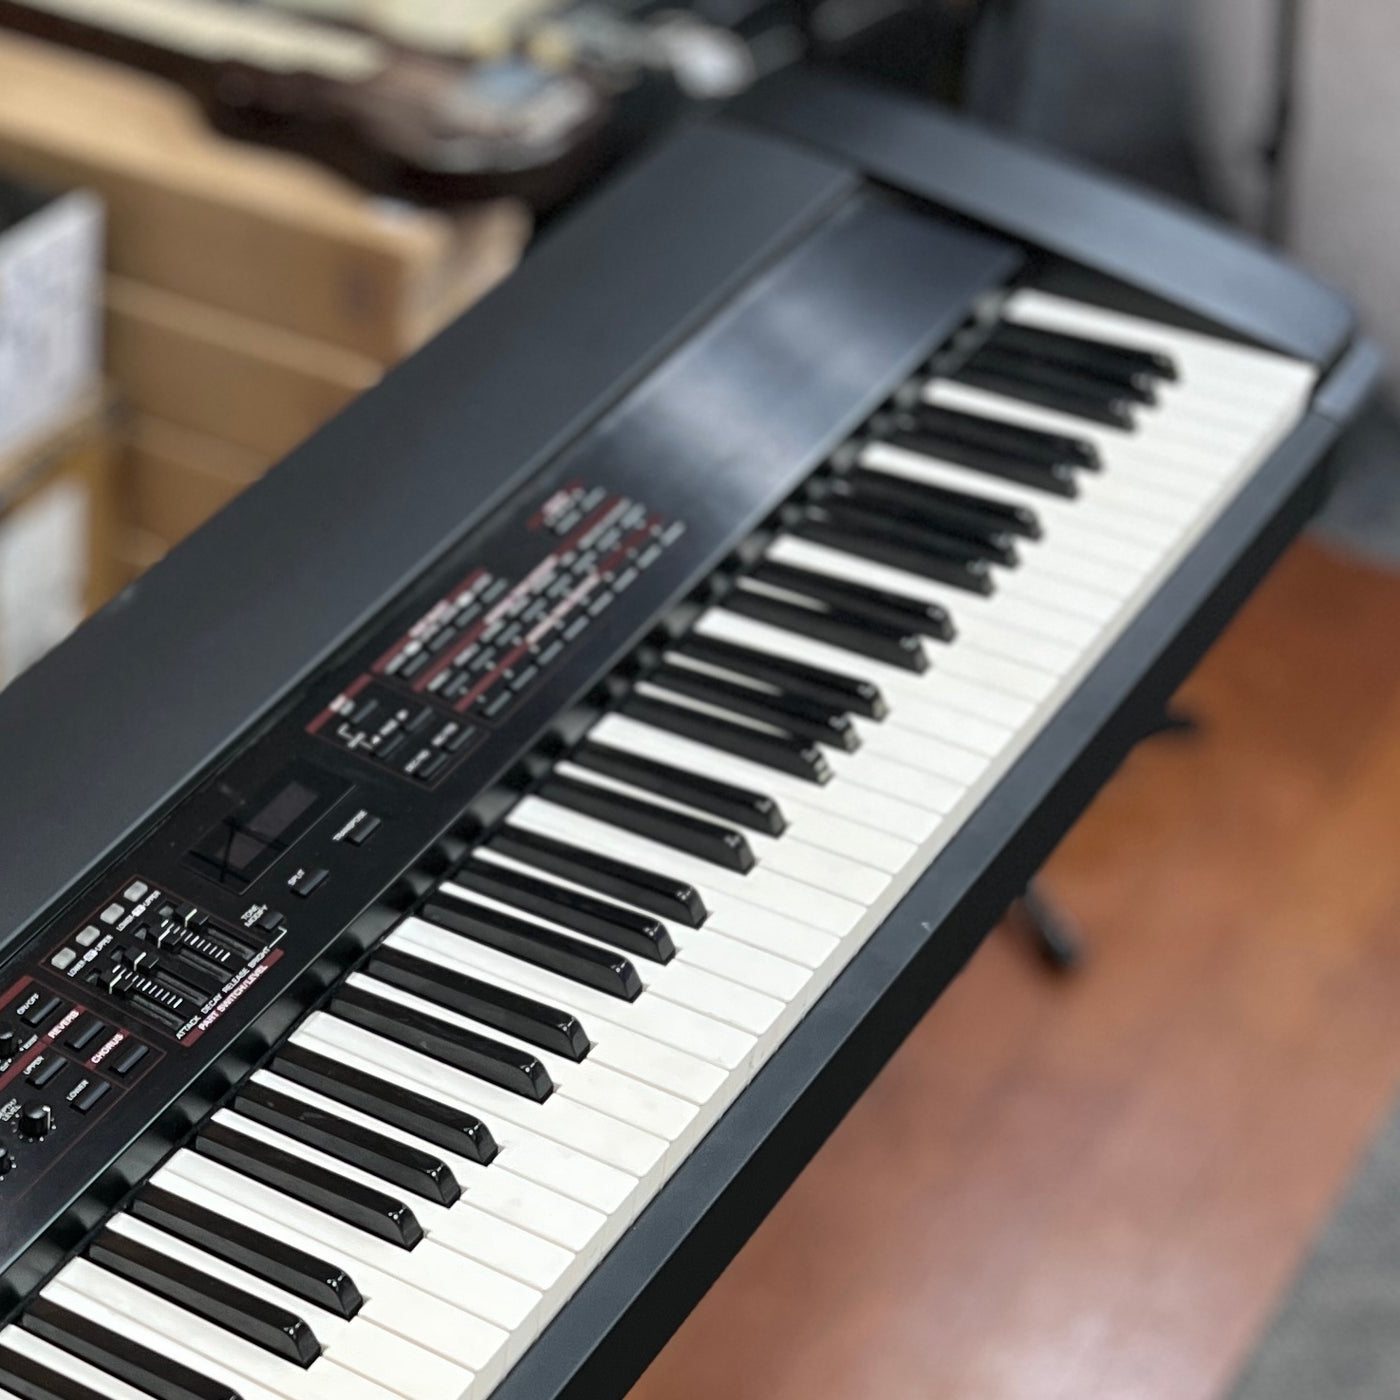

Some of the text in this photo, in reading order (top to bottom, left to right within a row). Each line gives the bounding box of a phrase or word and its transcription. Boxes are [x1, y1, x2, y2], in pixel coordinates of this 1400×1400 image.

[287, 868, 305, 886] SPLIT
[175, 945, 271, 1040] ATTACK DECAY RELEASE BRIGHT
[197, 964, 269, 1031] PART SWITCH/LEVEL
[47, 1009, 80, 1039] REVERB
[90, 1033, 124, 1064] CHORUS
[66, 1079, 89, 1101] LOWER
